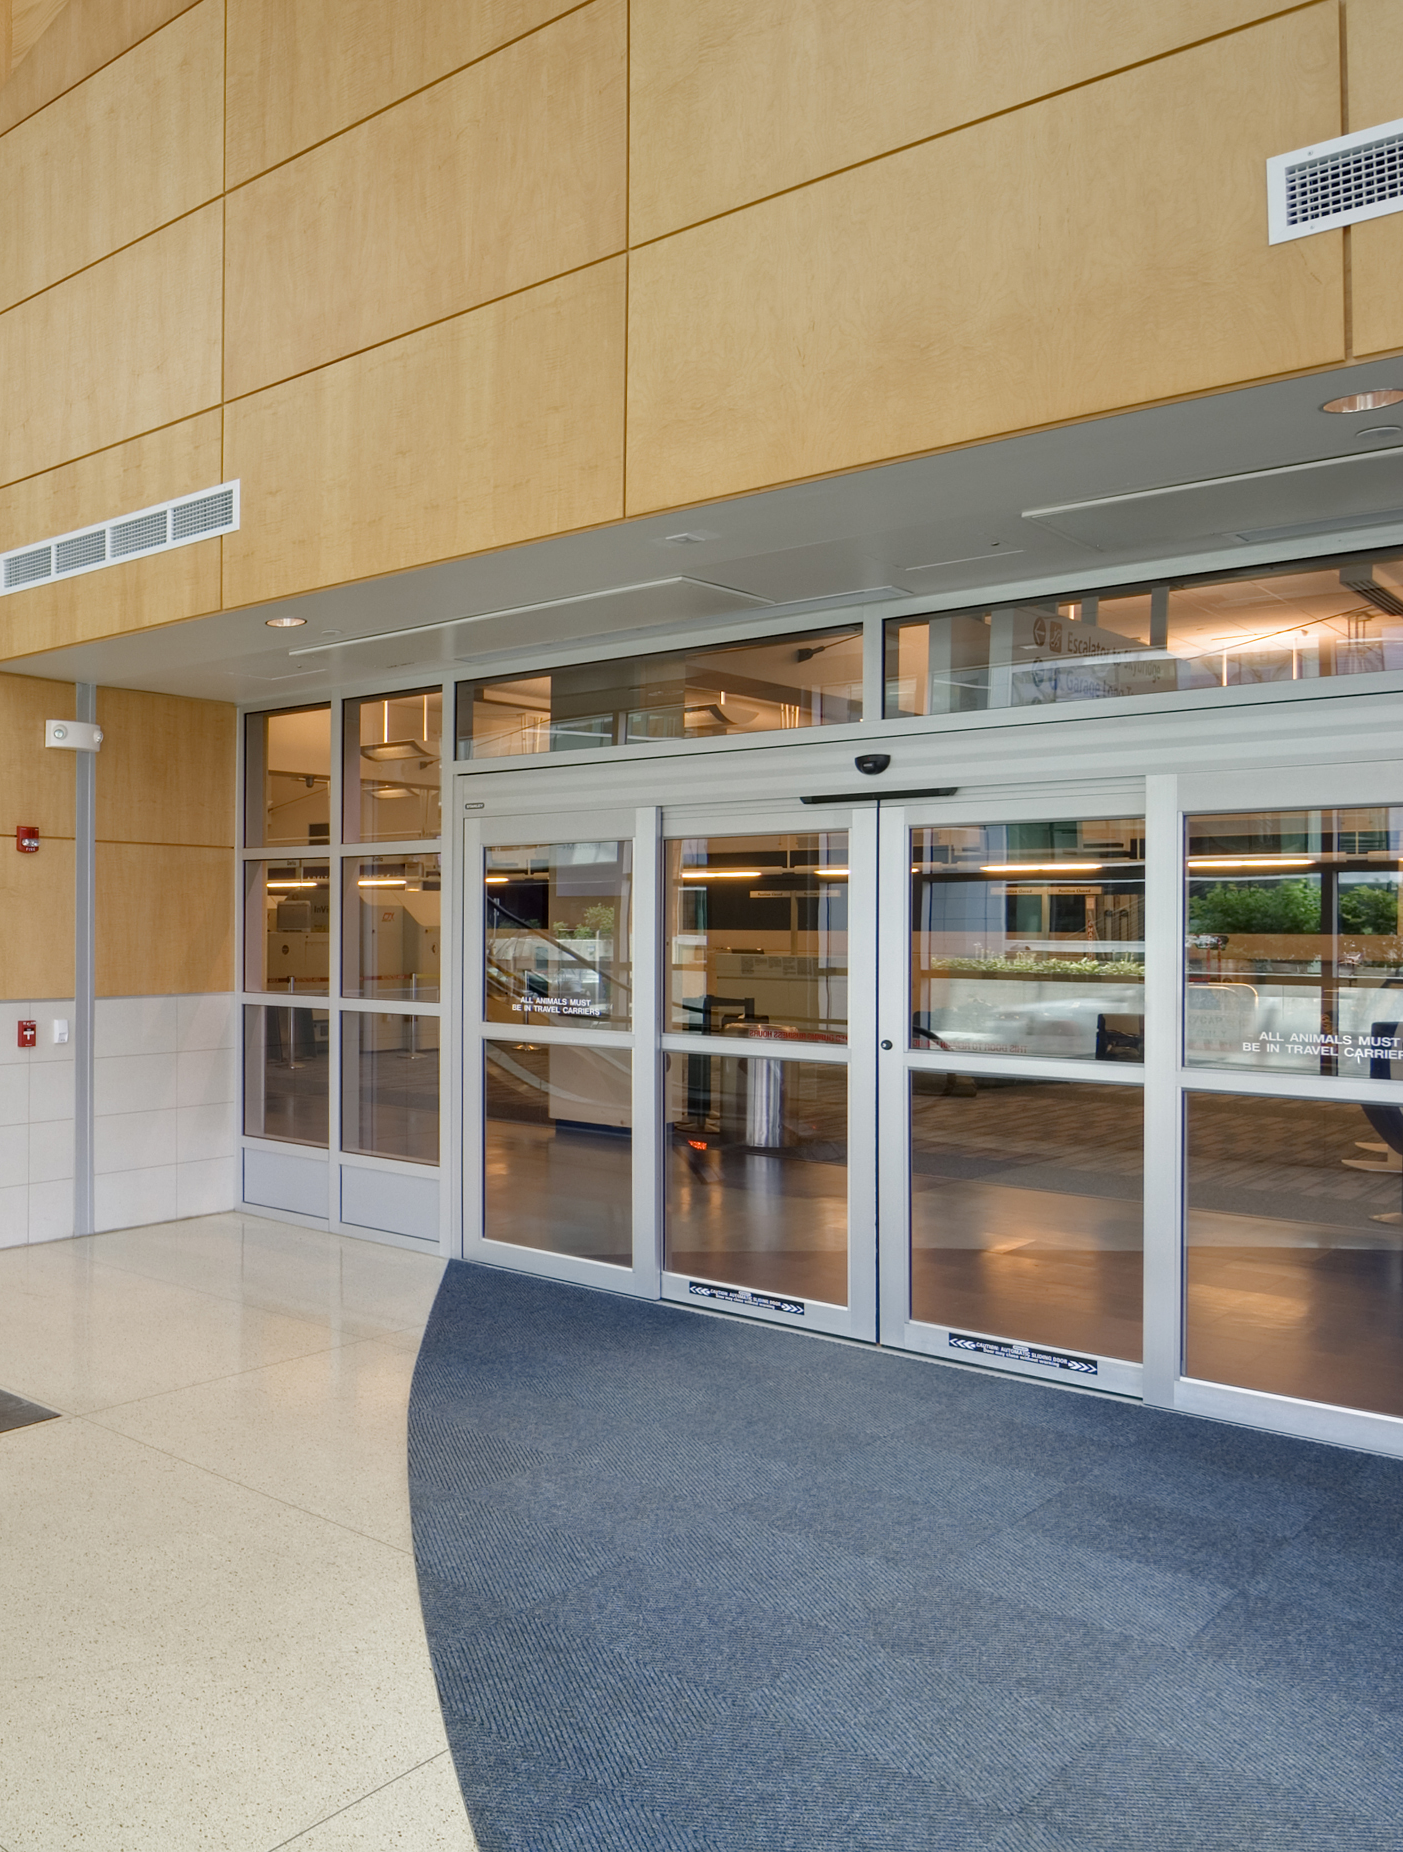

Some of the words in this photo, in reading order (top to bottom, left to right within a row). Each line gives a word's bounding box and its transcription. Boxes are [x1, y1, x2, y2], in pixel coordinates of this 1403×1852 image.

[1067, 632, 1110, 661] Escalator
[520, 996, 534, 1004] ALL
[536, 997, 568, 1006] ANIMALS
[569, 999, 592, 1007] MUST
[512, 1003, 522, 1011] BE
[524, 1004, 532, 1012] IN
[534, 1005, 561, 1014] TRAVEL
[562, 1006, 601, 1016] CARRIERS
[1259, 1031, 1285, 1042] ALL
[1289, 1032, 1353, 1046] ANIMALS
[1358, 1035, 1401, 1048] MUST
[1242, 1042, 1261, 1052] BE
[1266, 1043, 1280, 1053] IN
[1285, 1043, 1339, 1057] TRAVEL
